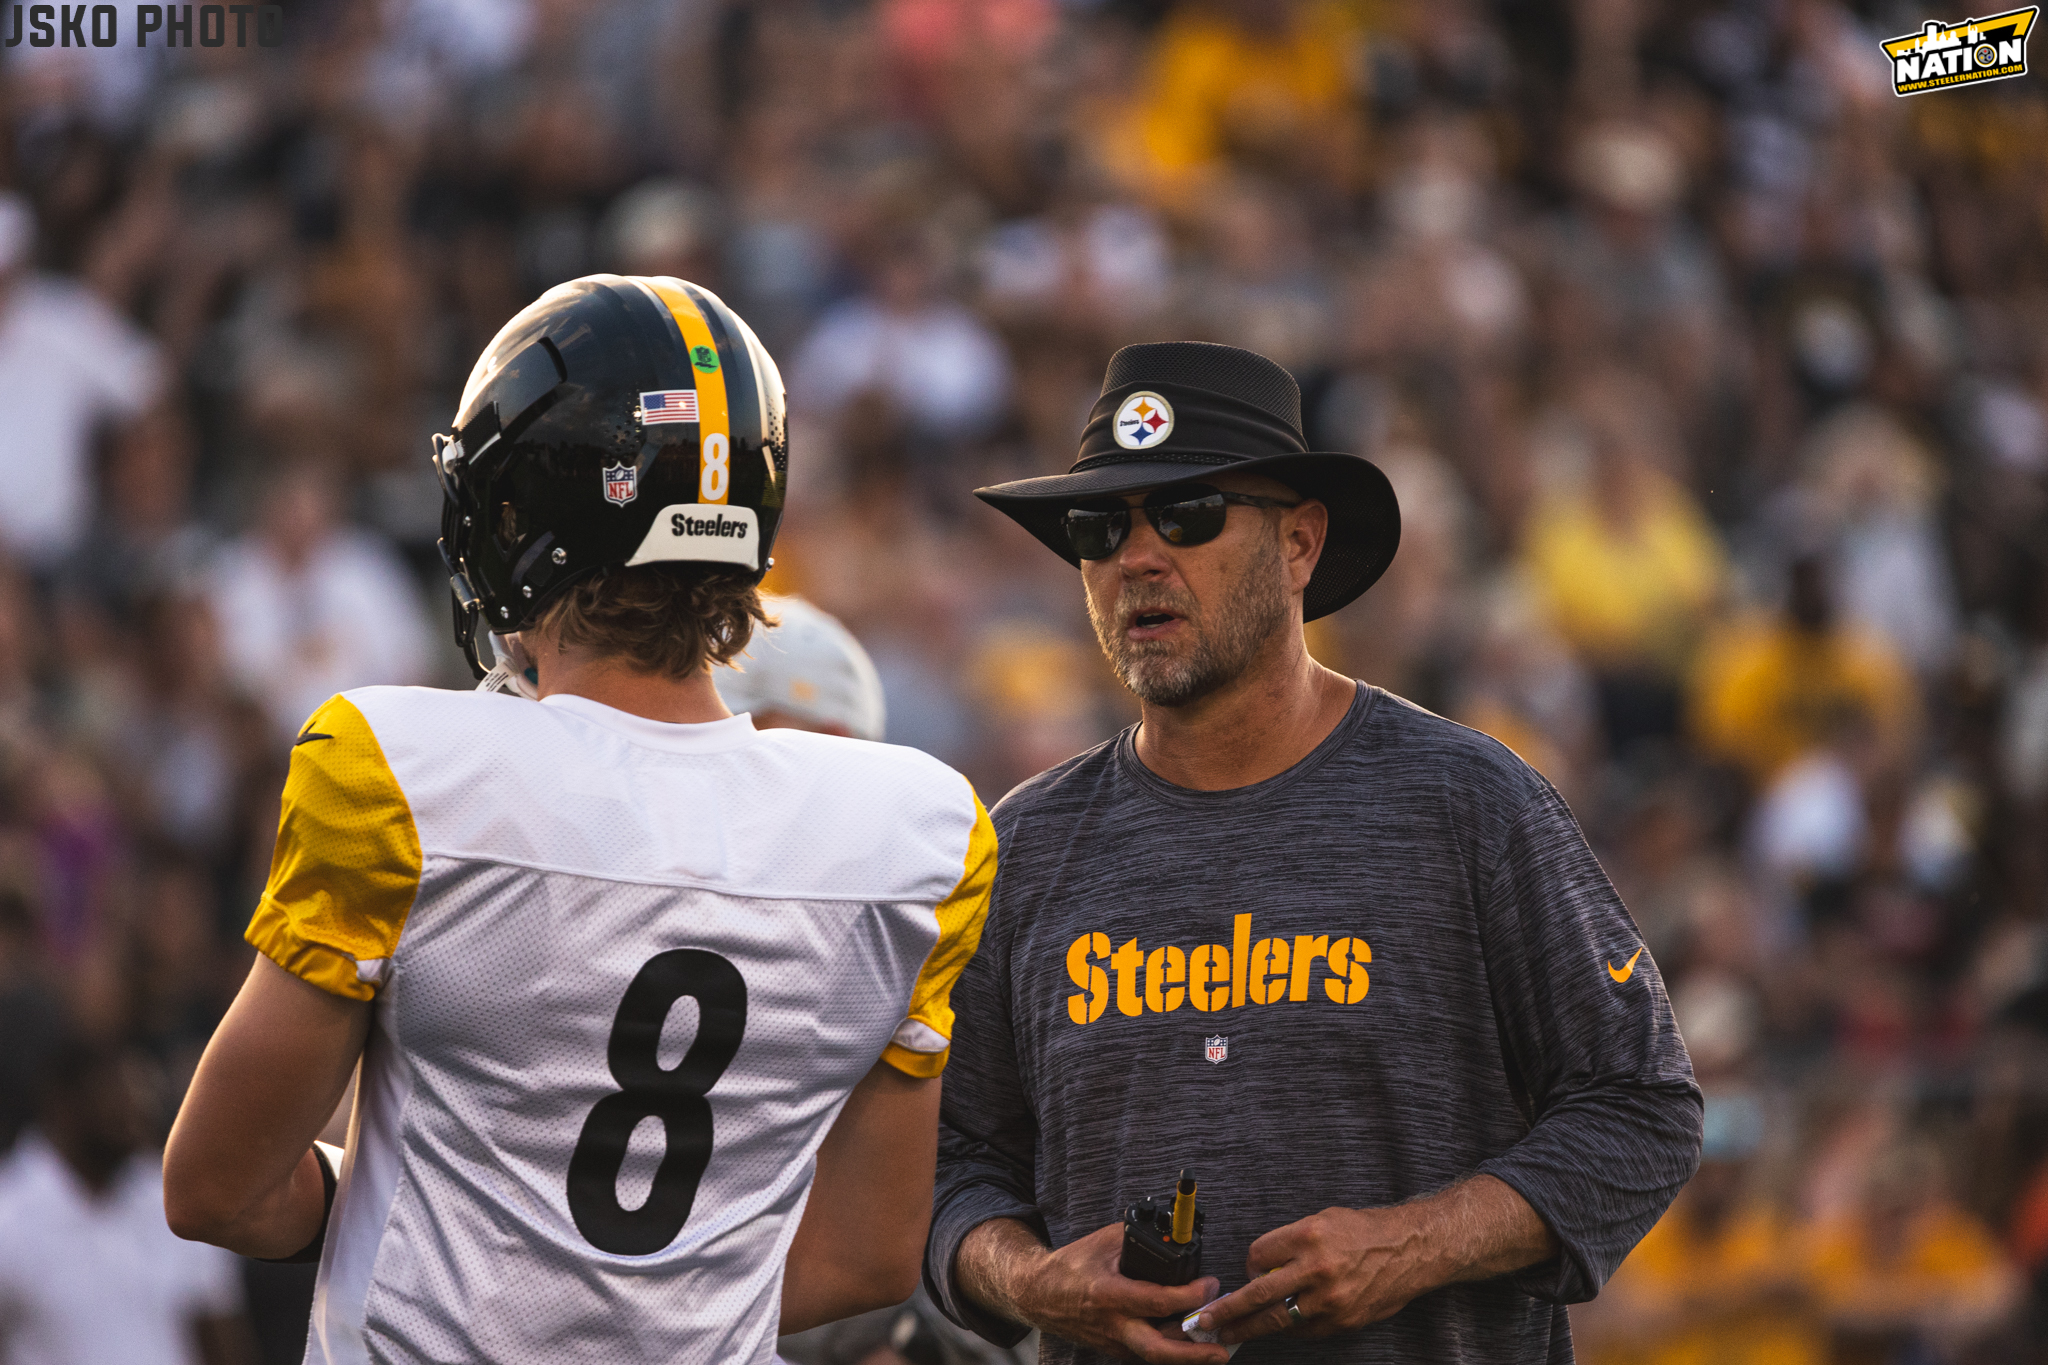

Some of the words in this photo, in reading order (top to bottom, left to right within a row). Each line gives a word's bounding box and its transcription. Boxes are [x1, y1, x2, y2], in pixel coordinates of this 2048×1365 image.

[701, 433, 728, 500] 8
[608, 482, 633, 499] NFL
[670, 513, 748, 539] Steelers
[1066, 912, 1372, 1025] Steelers
[1208, 1047, 1225, 1060] NFL
[567, 946, 748, 1256] 8
